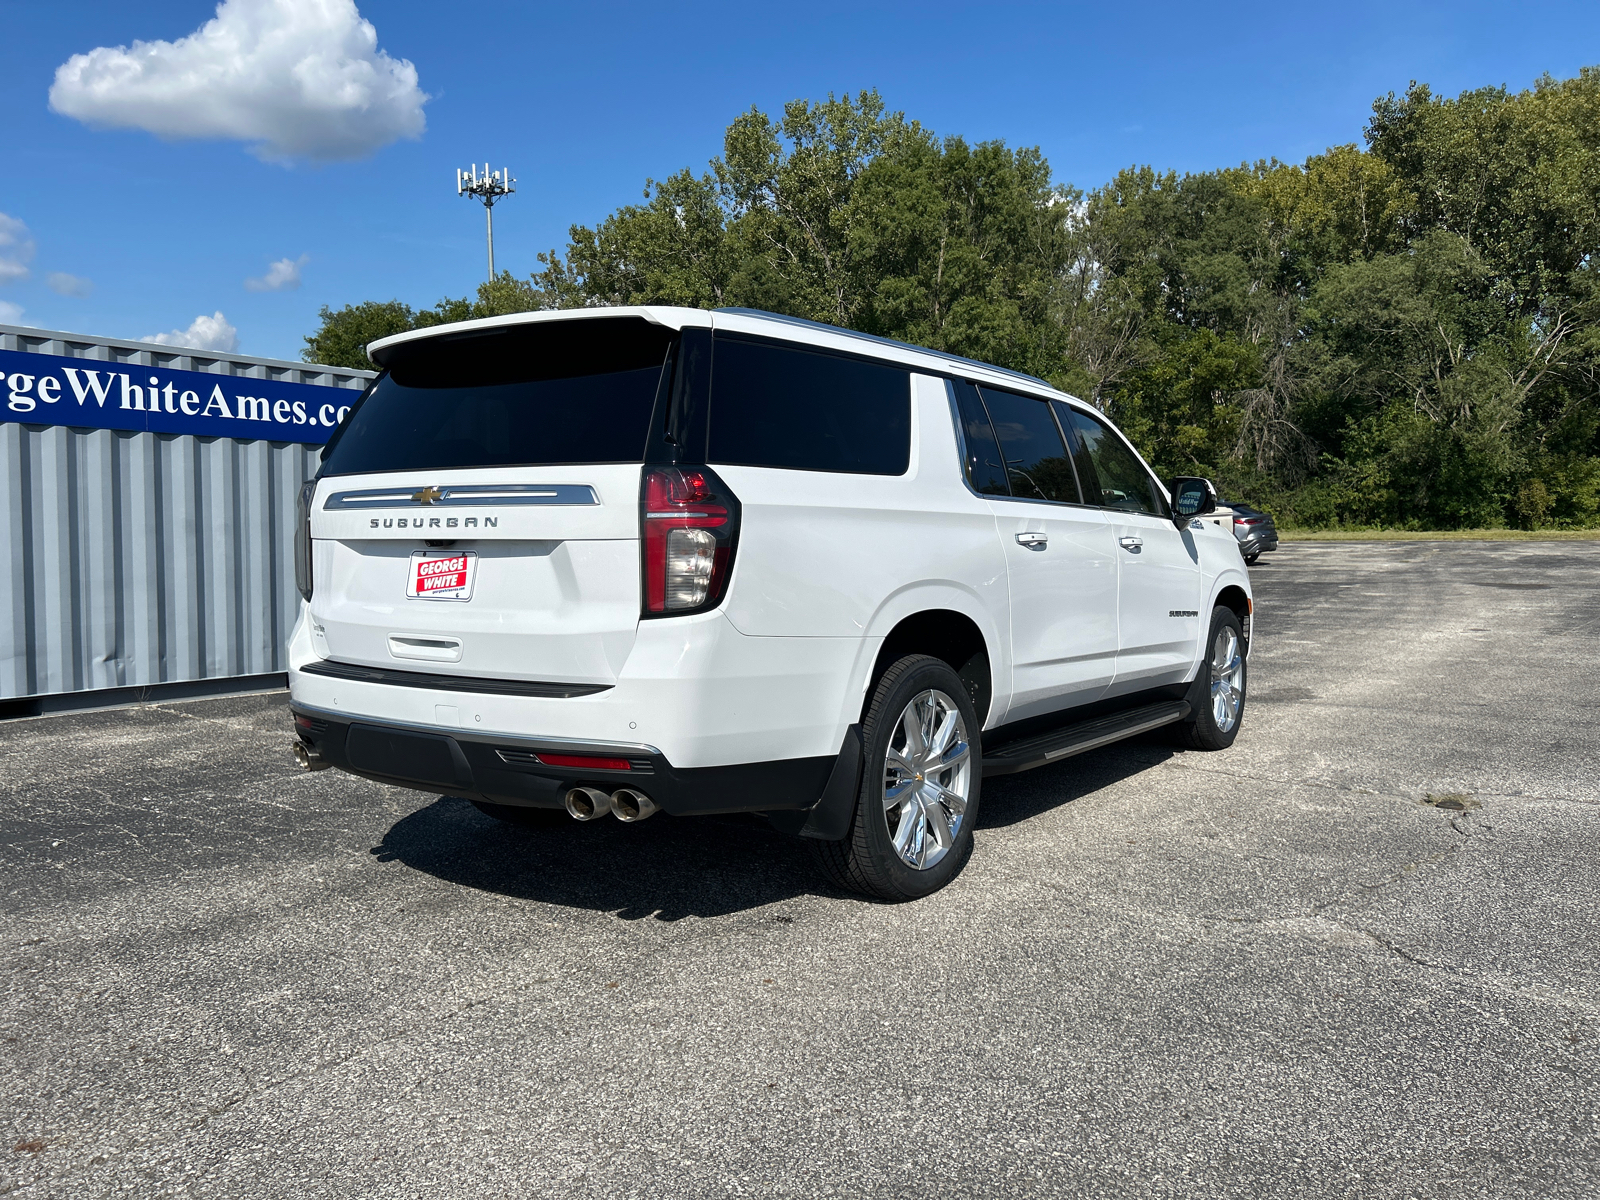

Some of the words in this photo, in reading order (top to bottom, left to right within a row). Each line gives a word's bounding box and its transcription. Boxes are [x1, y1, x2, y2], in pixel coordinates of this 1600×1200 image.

[0, 367, 351, 427] geWhiteAmes.c
[370, 517, 498, 528] SUBURBAN
[420, 558, 464, 575] GEORGE
[424, 574, 458, 590] WHITE
